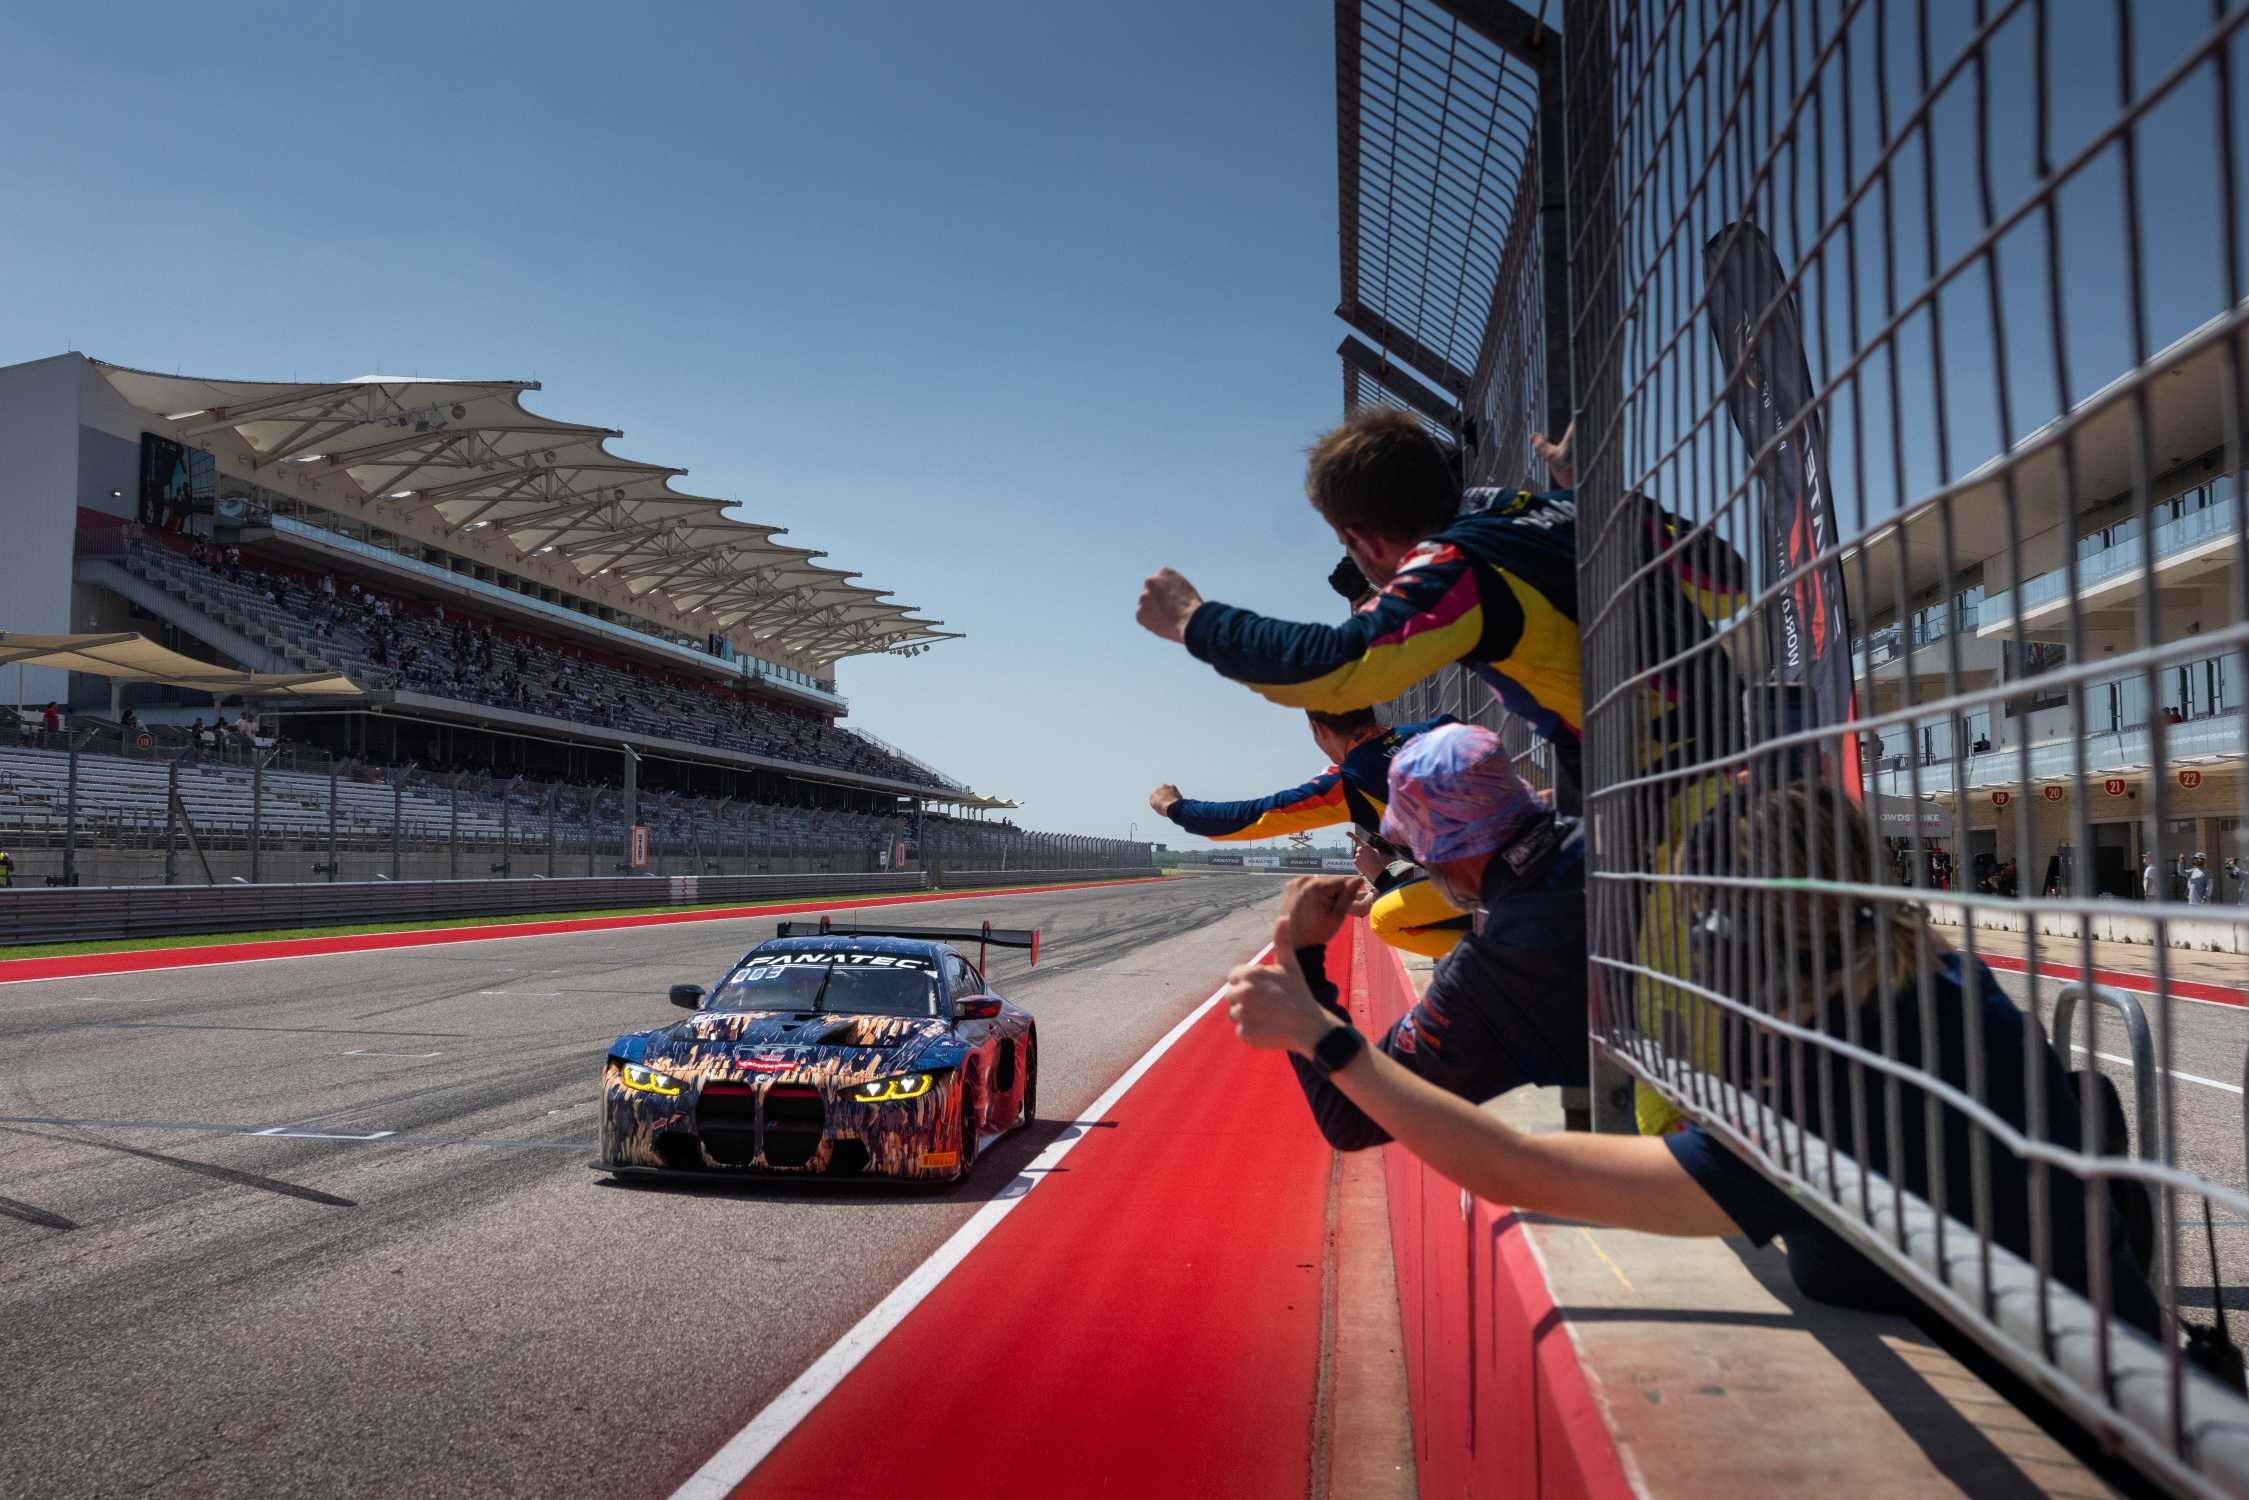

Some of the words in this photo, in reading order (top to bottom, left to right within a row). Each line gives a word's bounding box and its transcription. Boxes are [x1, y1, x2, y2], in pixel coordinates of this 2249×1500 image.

[2183, 773, 2197, 785] 22
[2110, 781, 2120, 792] 21
[1996, 793, 2005, 803] 19
[2048, 788, 2060, 799] 20
[746, 954, 926, 969] FANATEC
[729, 966, 786, 983] 003
